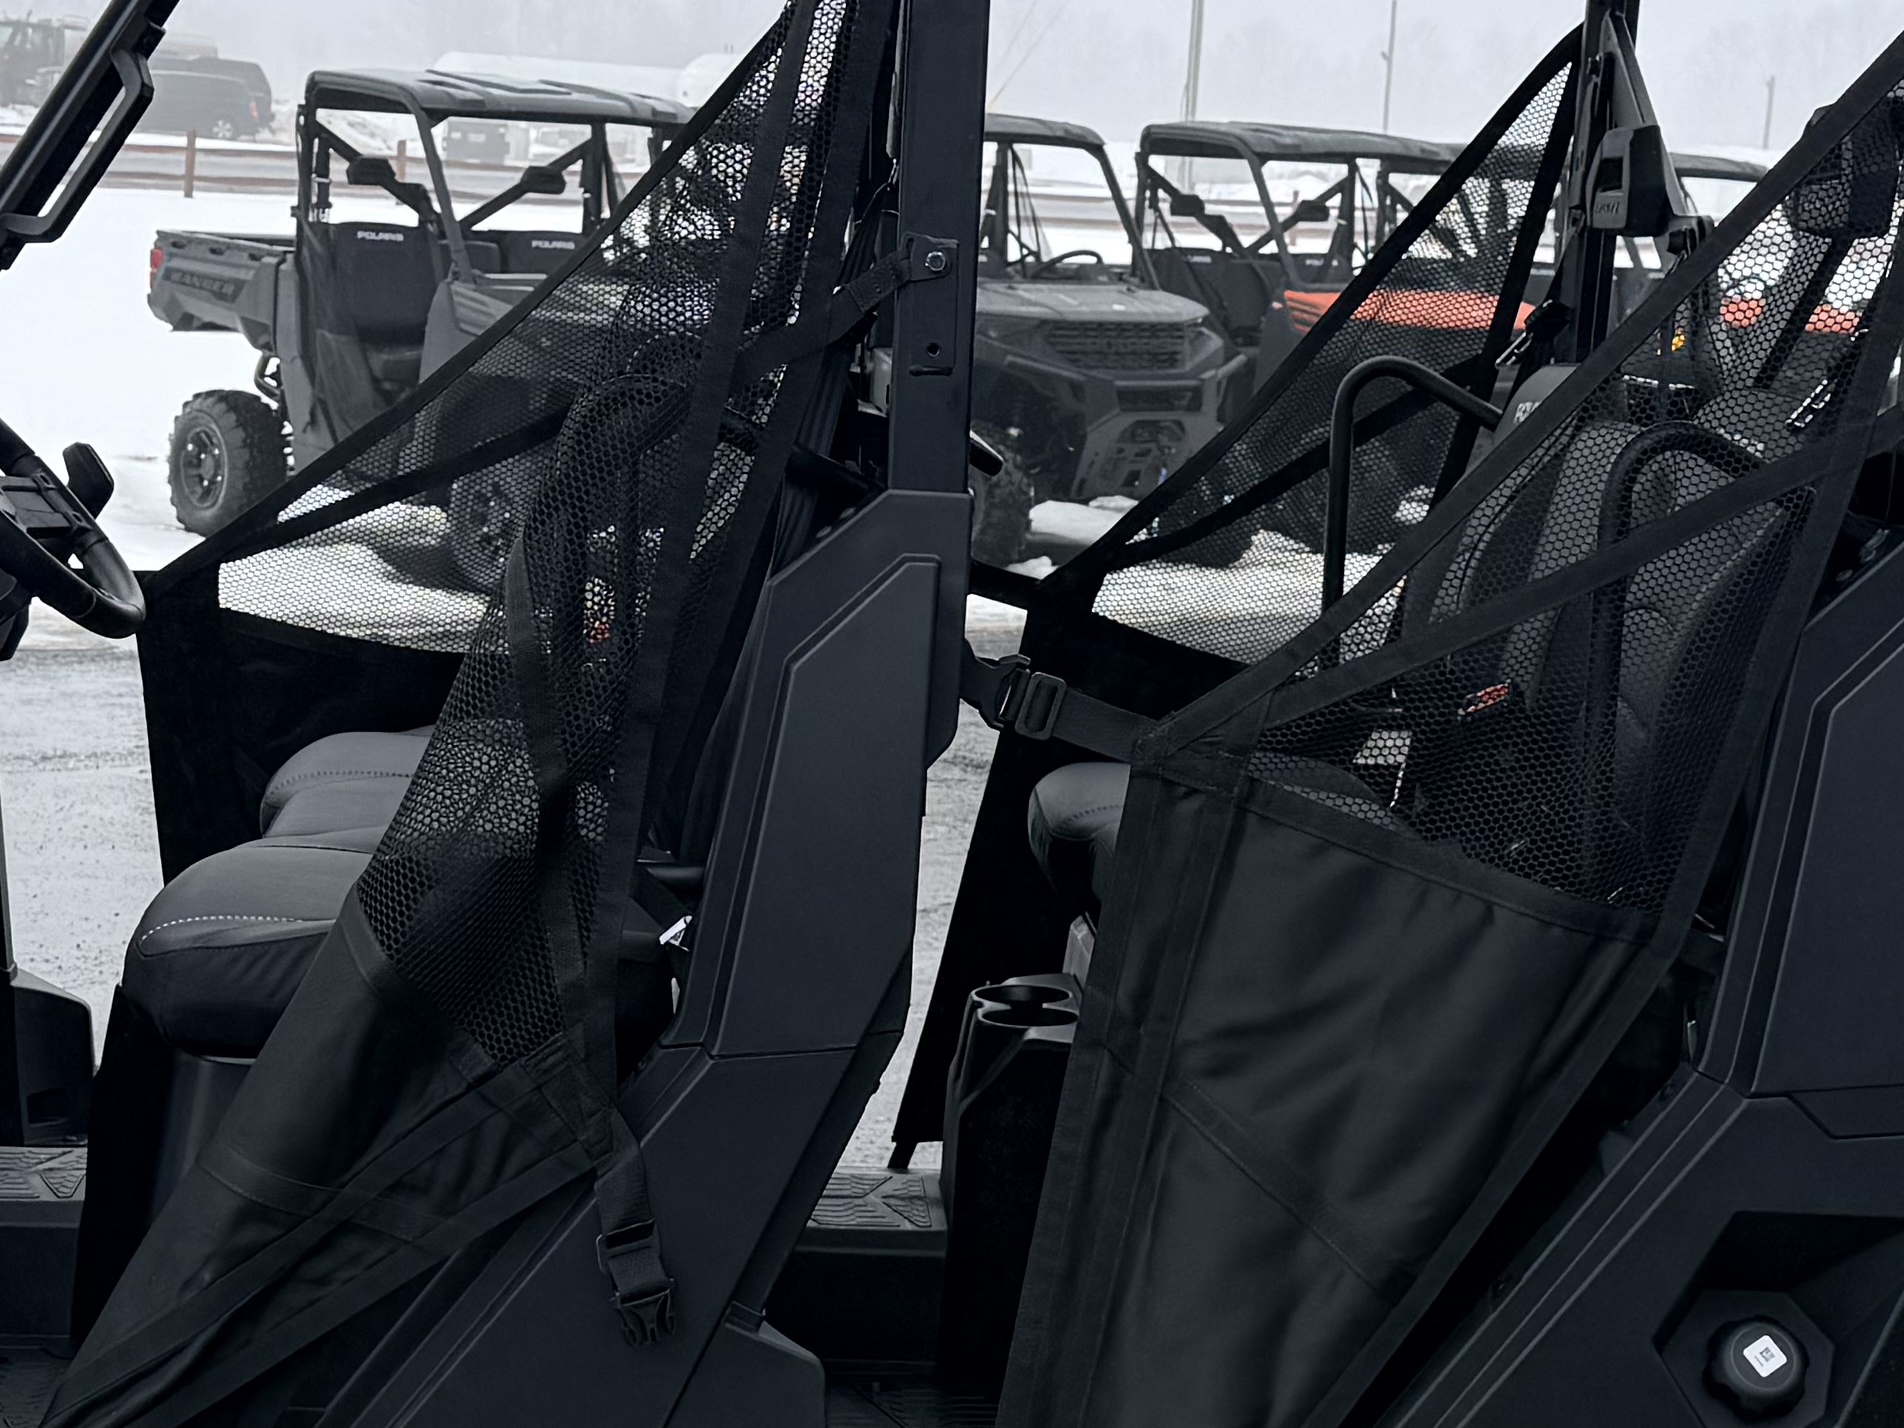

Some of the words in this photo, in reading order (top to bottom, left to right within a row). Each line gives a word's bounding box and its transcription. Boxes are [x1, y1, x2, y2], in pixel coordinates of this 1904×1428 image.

[357, 231, 404, 241] POLARIS
[531, 240, 575, 249] POLARIS
[170, 271, 235, 294] RANGER
